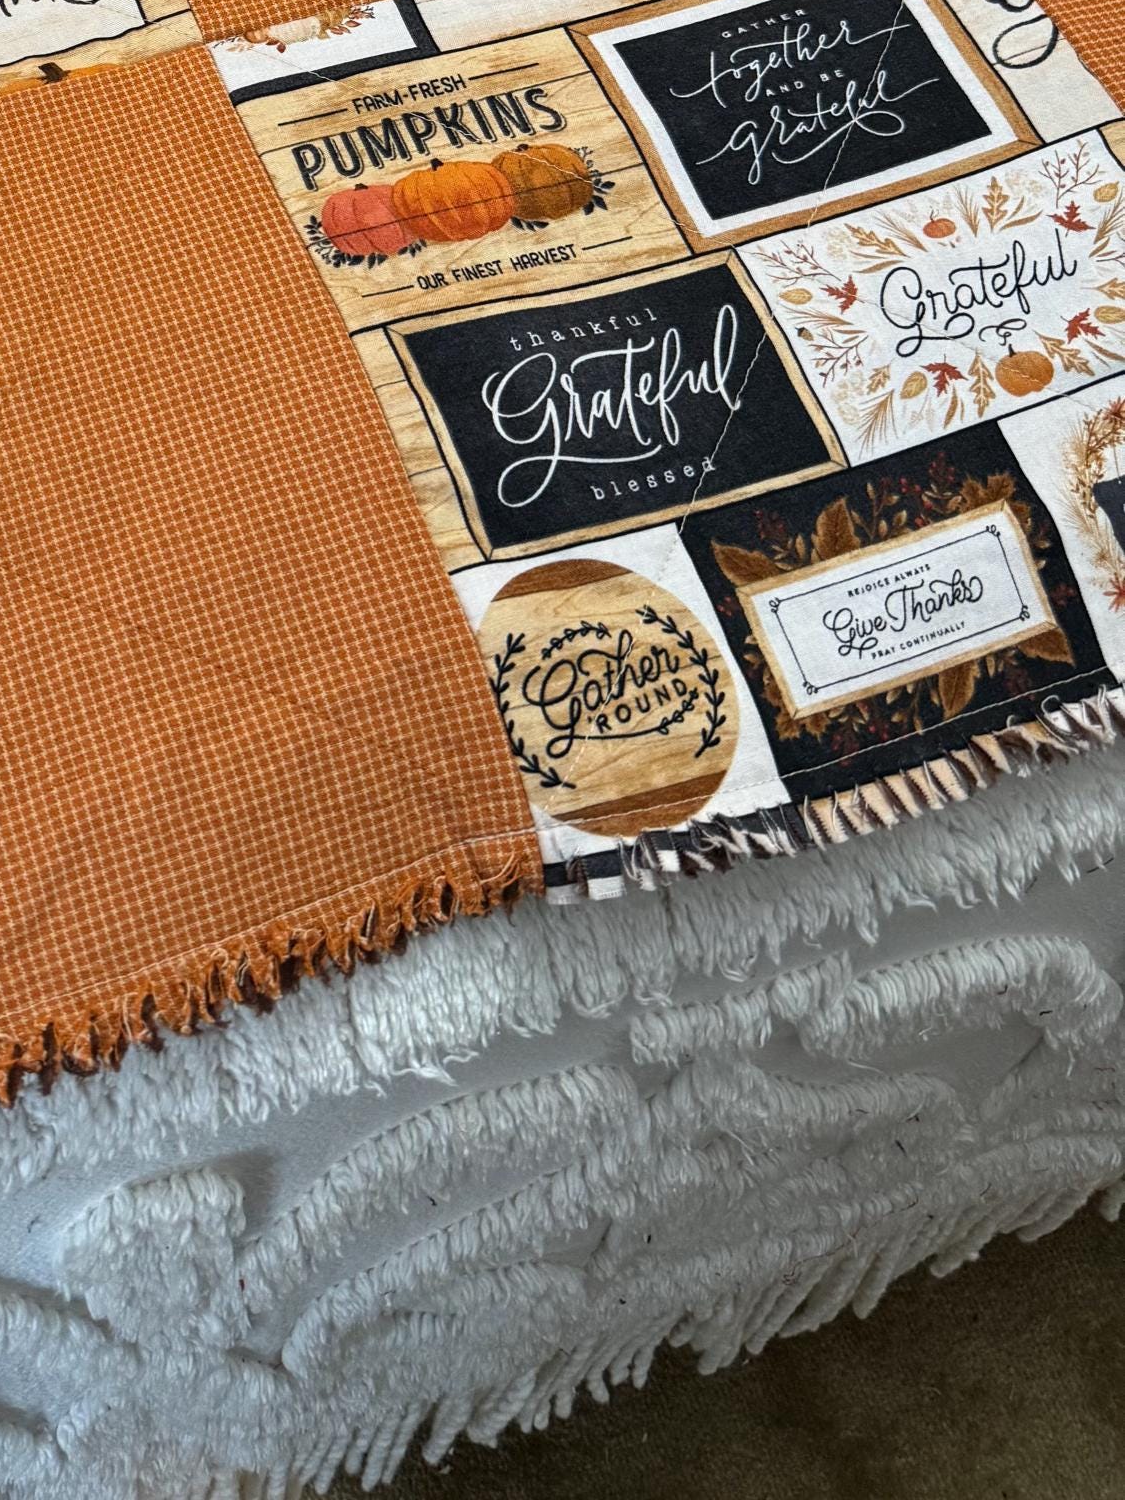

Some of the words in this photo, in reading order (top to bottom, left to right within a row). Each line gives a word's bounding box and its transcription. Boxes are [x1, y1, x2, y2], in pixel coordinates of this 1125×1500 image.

[720, 8, 808, 39] GATHER
[668, 20, 913, 109] together
[765, 80, 804, 98] AND
[820, 69, 844, 82] BE
[352, 73, 467, 115] FARM-FRESH
[291, 87, 567, 193] PUMPKINS
[696, 68, 940, 186] grateful
[416, 274, 446, 292] OUR
[452, 260, 503, 283] FINEST
[510, 243, 577, 272] HARVEST
[880, 228, 1077, 357] Grateful
[509, 308, 659, 353] thankful
[481, 303, 742, 509] Grateful
[589, 455, 717, 501] blessed
[847, 576, 890, 598] REJOICE
[894, 562, 932, 584] ALWAYS
[823, 607, 887, 659] Give
[884, 569, 984, 633] Thanks
[871, 645, 896, 661] PRAY
[899, 621, 967, 652] CONTINUALLY
[521, 628, 680, 759] Gather
